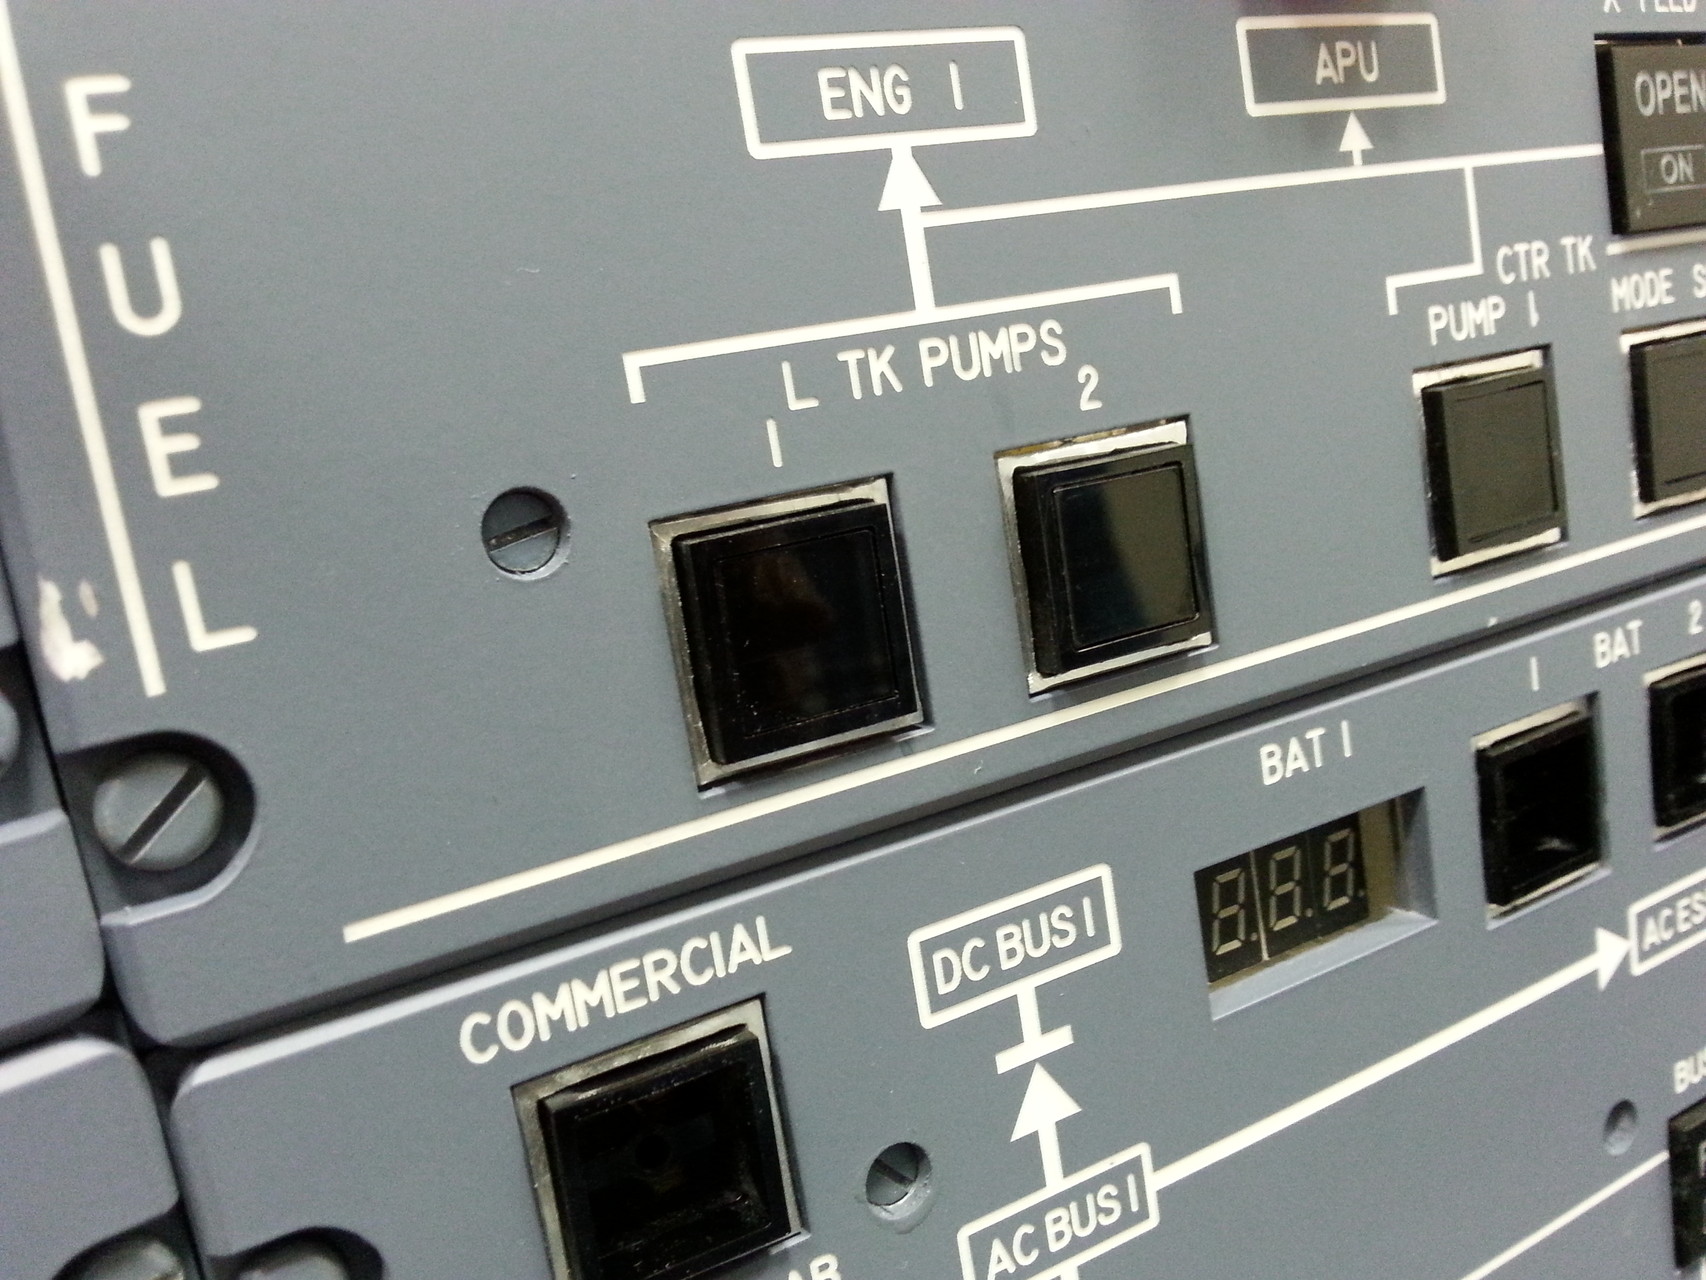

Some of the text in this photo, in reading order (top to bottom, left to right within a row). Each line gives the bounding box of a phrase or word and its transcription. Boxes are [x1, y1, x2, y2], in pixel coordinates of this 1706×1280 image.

[1315, 41, 1380, 85] APU
[818, 67, 912, 121] ENG
[1635, 69, 1706, 117] OPEN
[1661, 152, 1695, 185] ON
[1497, 234, 1597, 285] CTR TK
[1610, 267, 1676, 314] MODE
[1427, 295, 1506, 346] PUMP
[781, 319, 1068, 411] L TK PUMPS
[1077, 364, 1103, 412] 2
[1592, 619, 1643, 669] BAT
[1686, 597, 1703, 637] 2
[1259, 727, 1327, 786] BAT
[932, 938, 991, 996] DC
[995, 905, 1077, 971] BUS
[459, 915, 793, 1065] COMMERCIAL
[987, 1223, 1040, 1280] AC
[1045, 1184, 1122, 1253] BUS
